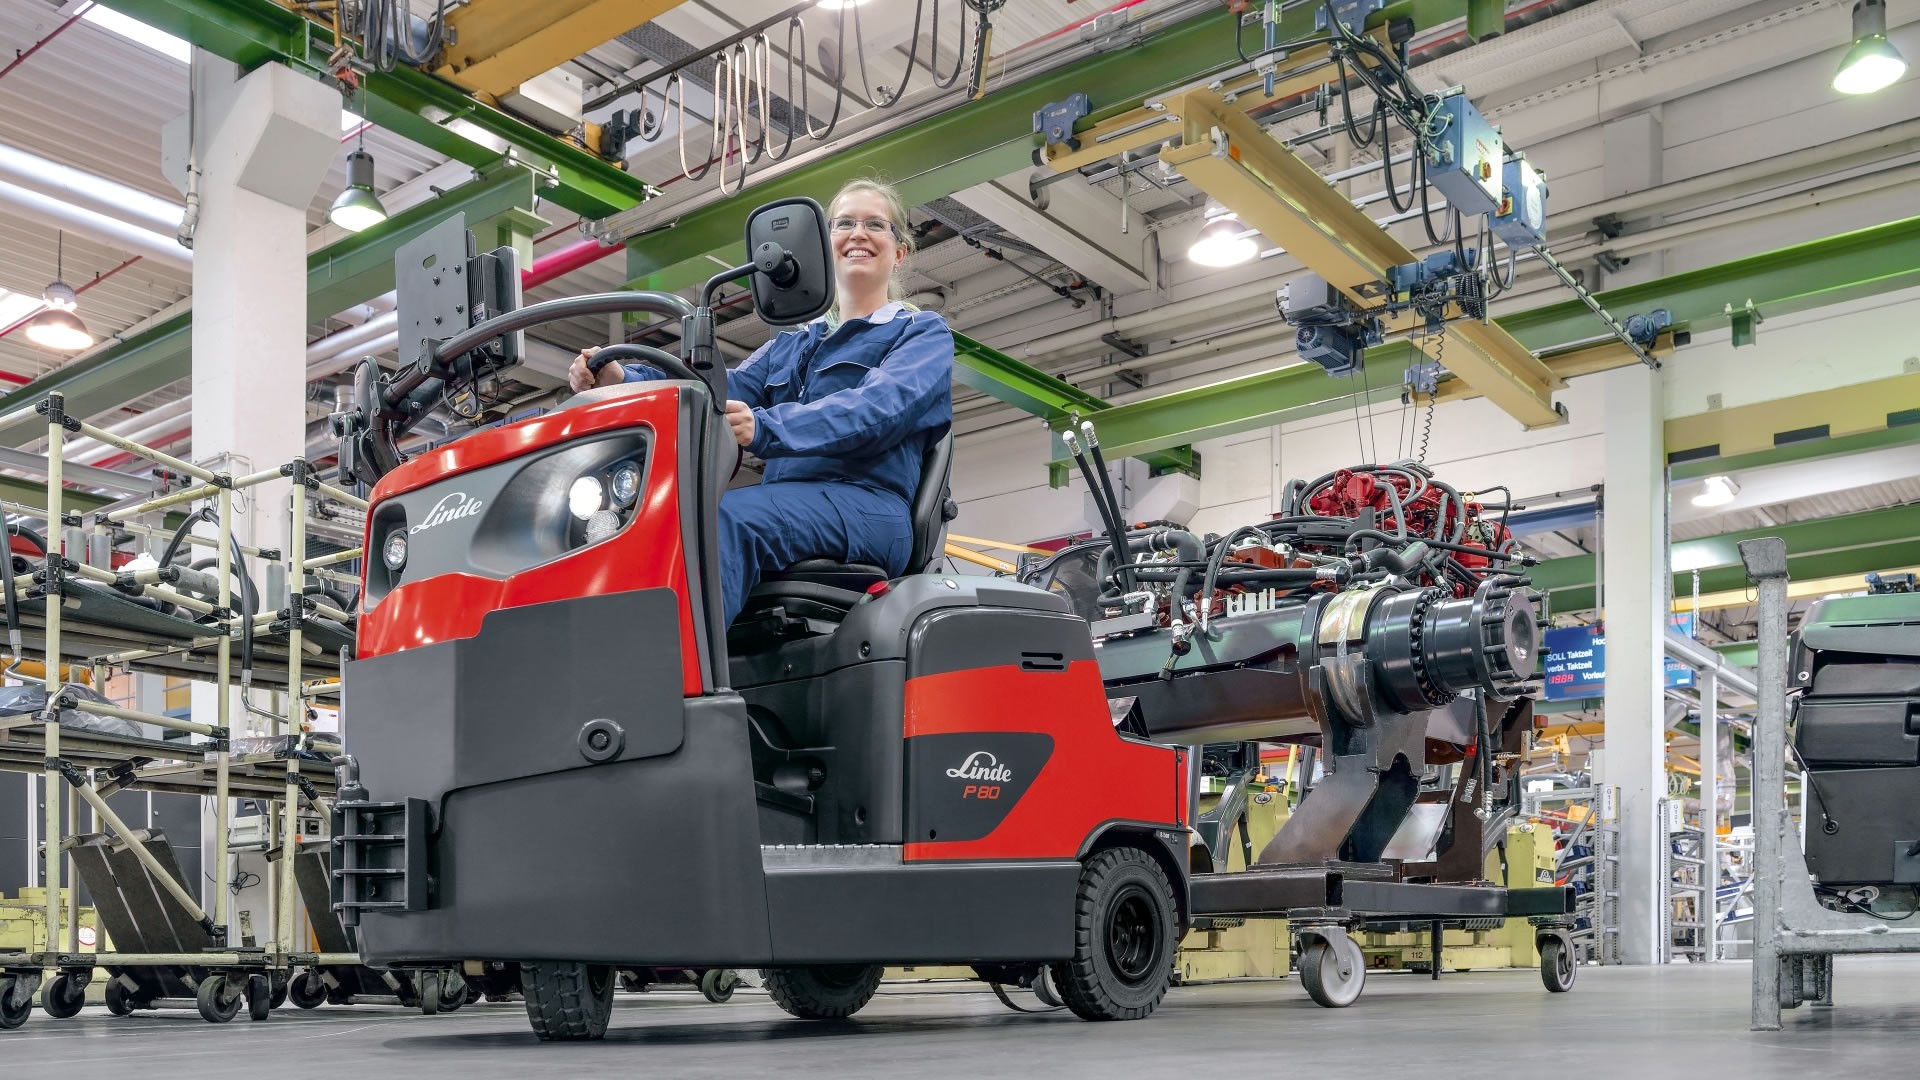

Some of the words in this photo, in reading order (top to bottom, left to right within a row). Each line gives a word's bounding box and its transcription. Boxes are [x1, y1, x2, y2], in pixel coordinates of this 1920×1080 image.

[410, 492, 482, 534] Linde
[1547, 653, 1566, 662] SOLL
[1567, 649, 1593, 659] Taktzeit
[1567, 661, 1592, 671] Taktzeit
[946, 751, 1012, 782] Linde
[963, 785, 977, 799] P
[977, 786, 1001, 799] 80
[1411, 951, 1424, 959] 112
